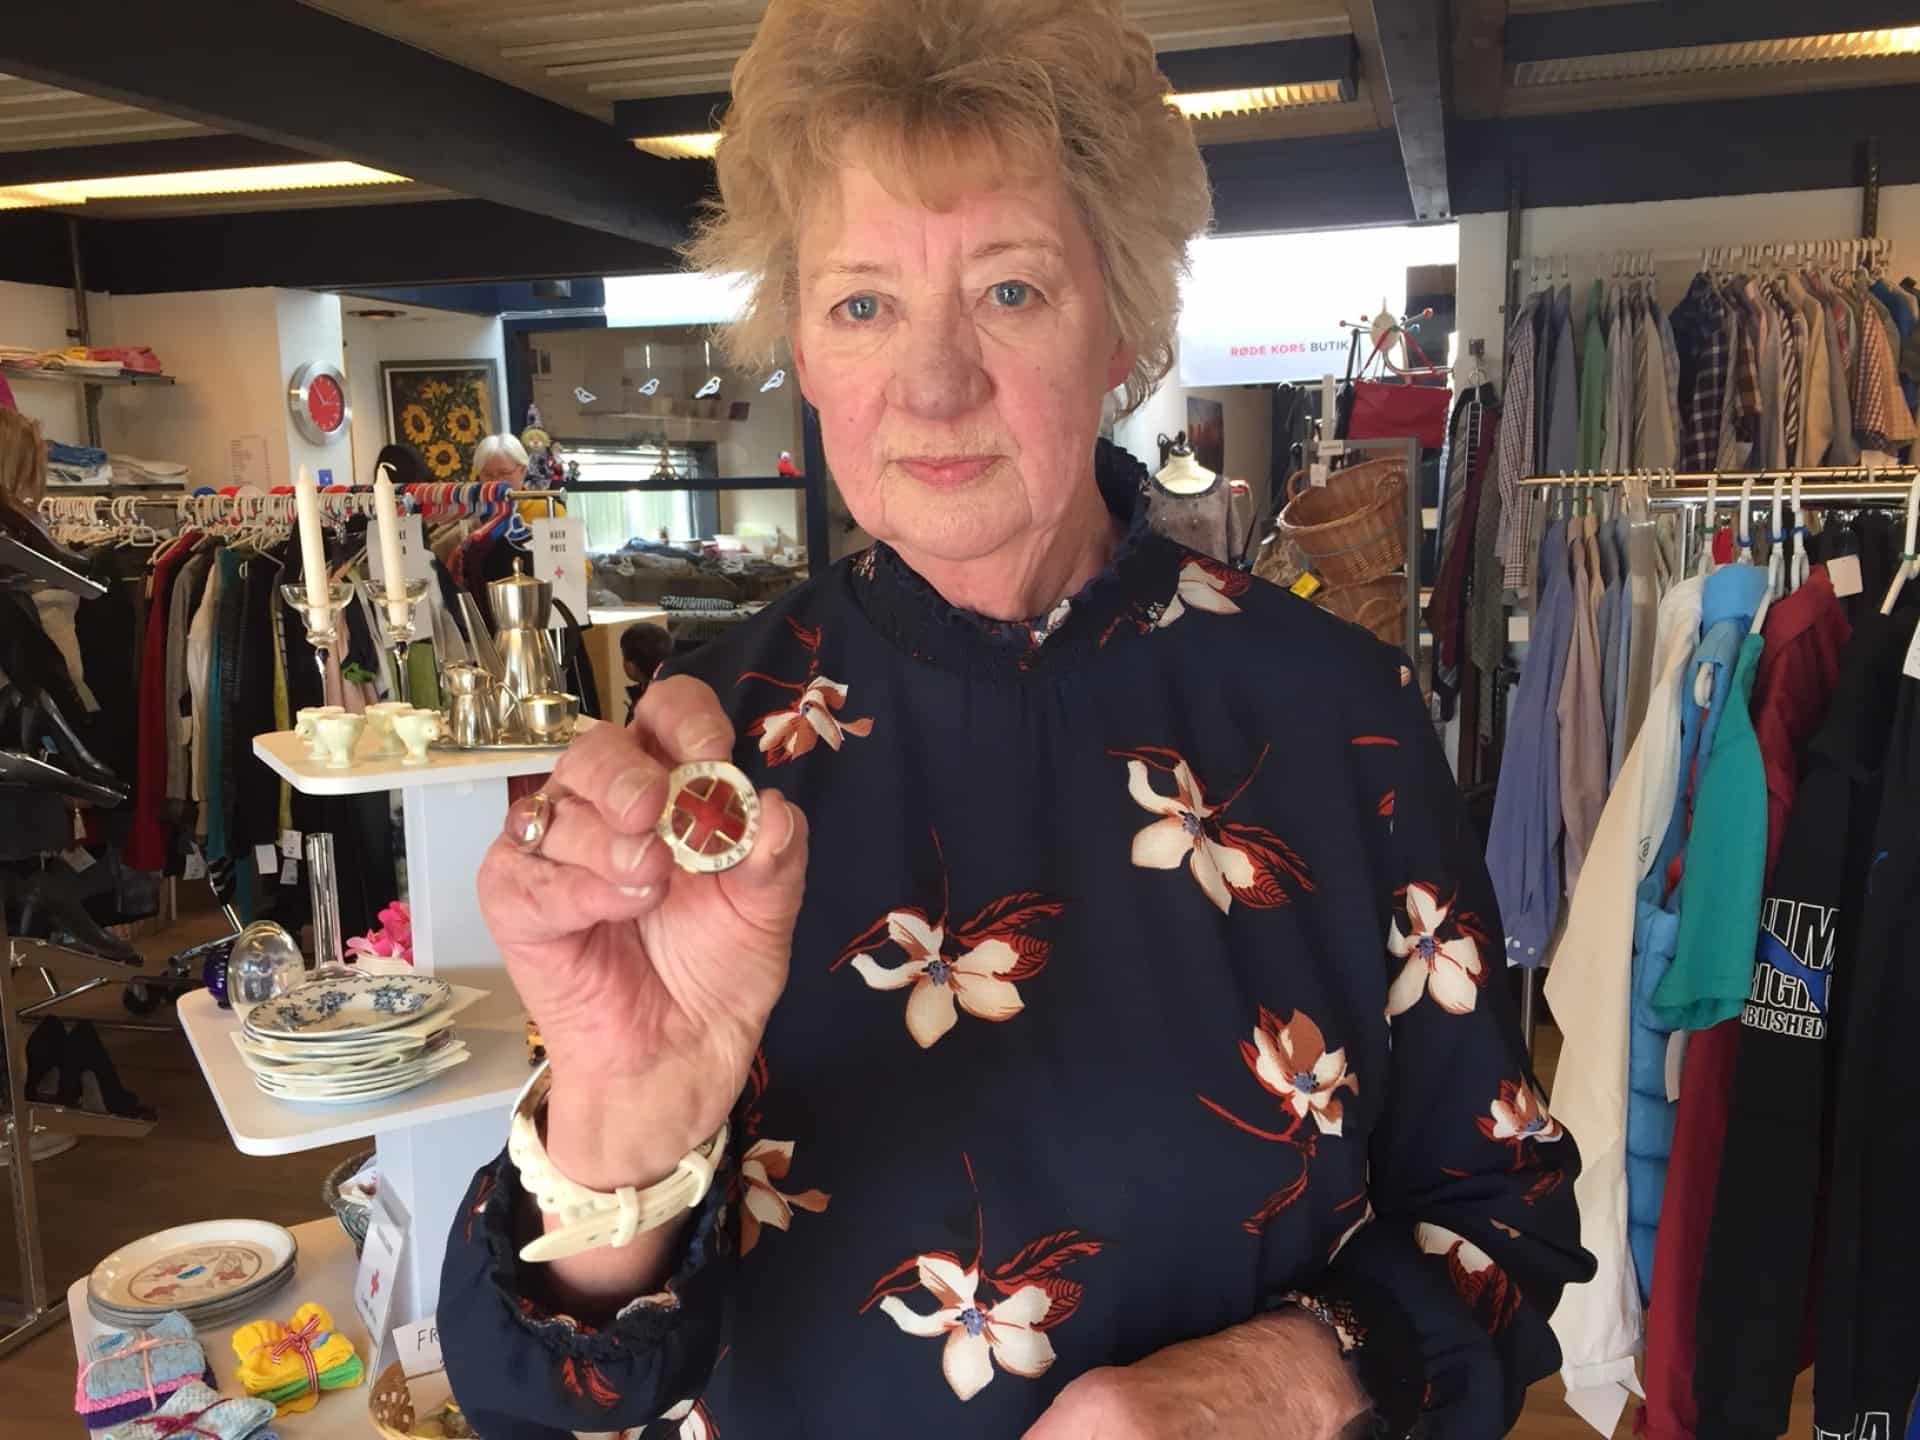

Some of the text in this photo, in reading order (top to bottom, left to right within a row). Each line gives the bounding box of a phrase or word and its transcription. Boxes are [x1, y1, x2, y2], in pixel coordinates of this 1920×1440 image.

[1231, 340, 1349, 357] RØDE KORS BUTIK
[1742, 1005, 1824, 1039] BLISHED
